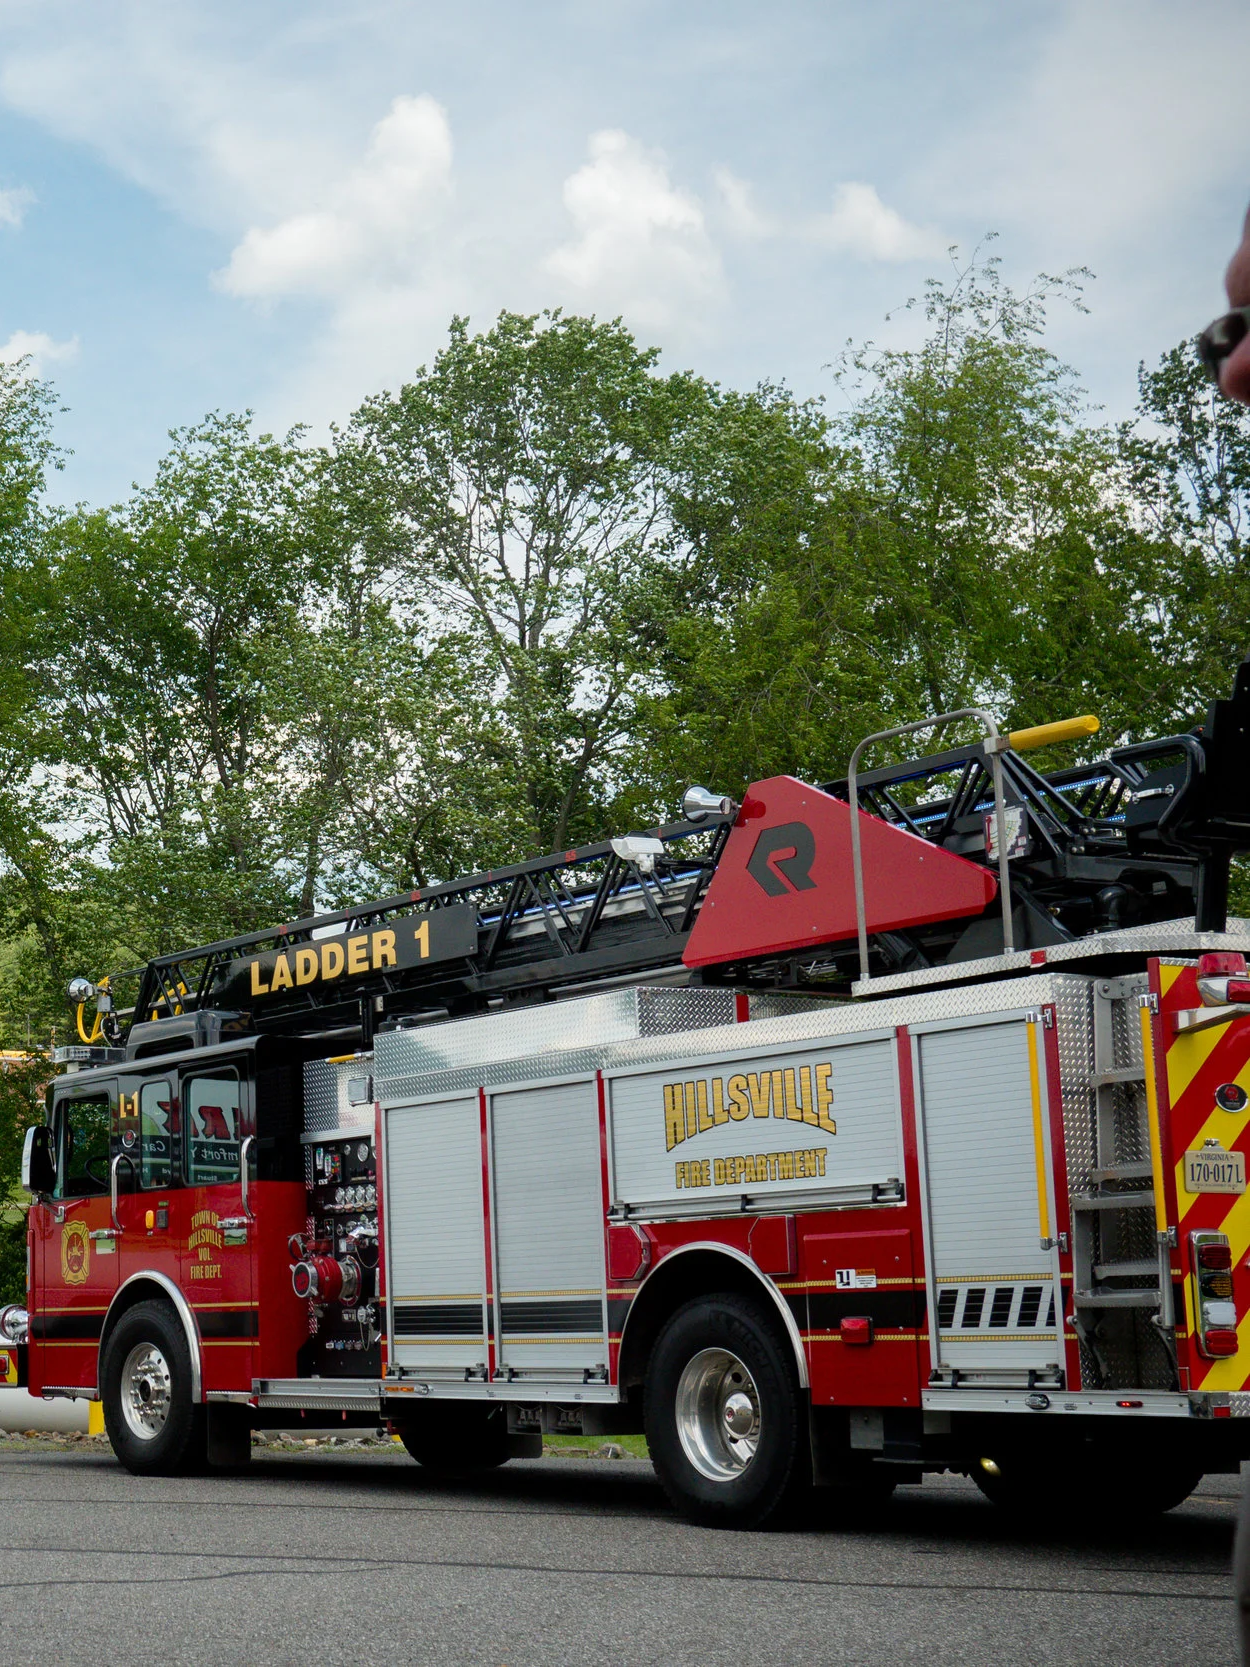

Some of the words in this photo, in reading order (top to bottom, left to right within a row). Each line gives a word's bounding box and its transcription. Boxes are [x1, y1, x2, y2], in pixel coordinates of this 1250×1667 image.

[250, 929, 397, 996] LADDER
[414, 919, 430, 959] 1
[119, 1091, 138, 1118] L-1
[662, 1062, 837, 1153] HILLSVILLE
[675, 1159, 711, 1189] FIRE
[713, 1147, 828, 1186] DEPARTMENT
[1200, 1153, 1229, 1161] VIRGINIA
[191, 1210, 210, 1230] TOWN
[188, 1228, 222, 1251] HILLSVILLE
[198, 1247, 213, 1261] VOL.
[190, 1265, 204, 1279] FIRE
[204, 1264, 222, 1279] DEPT.
